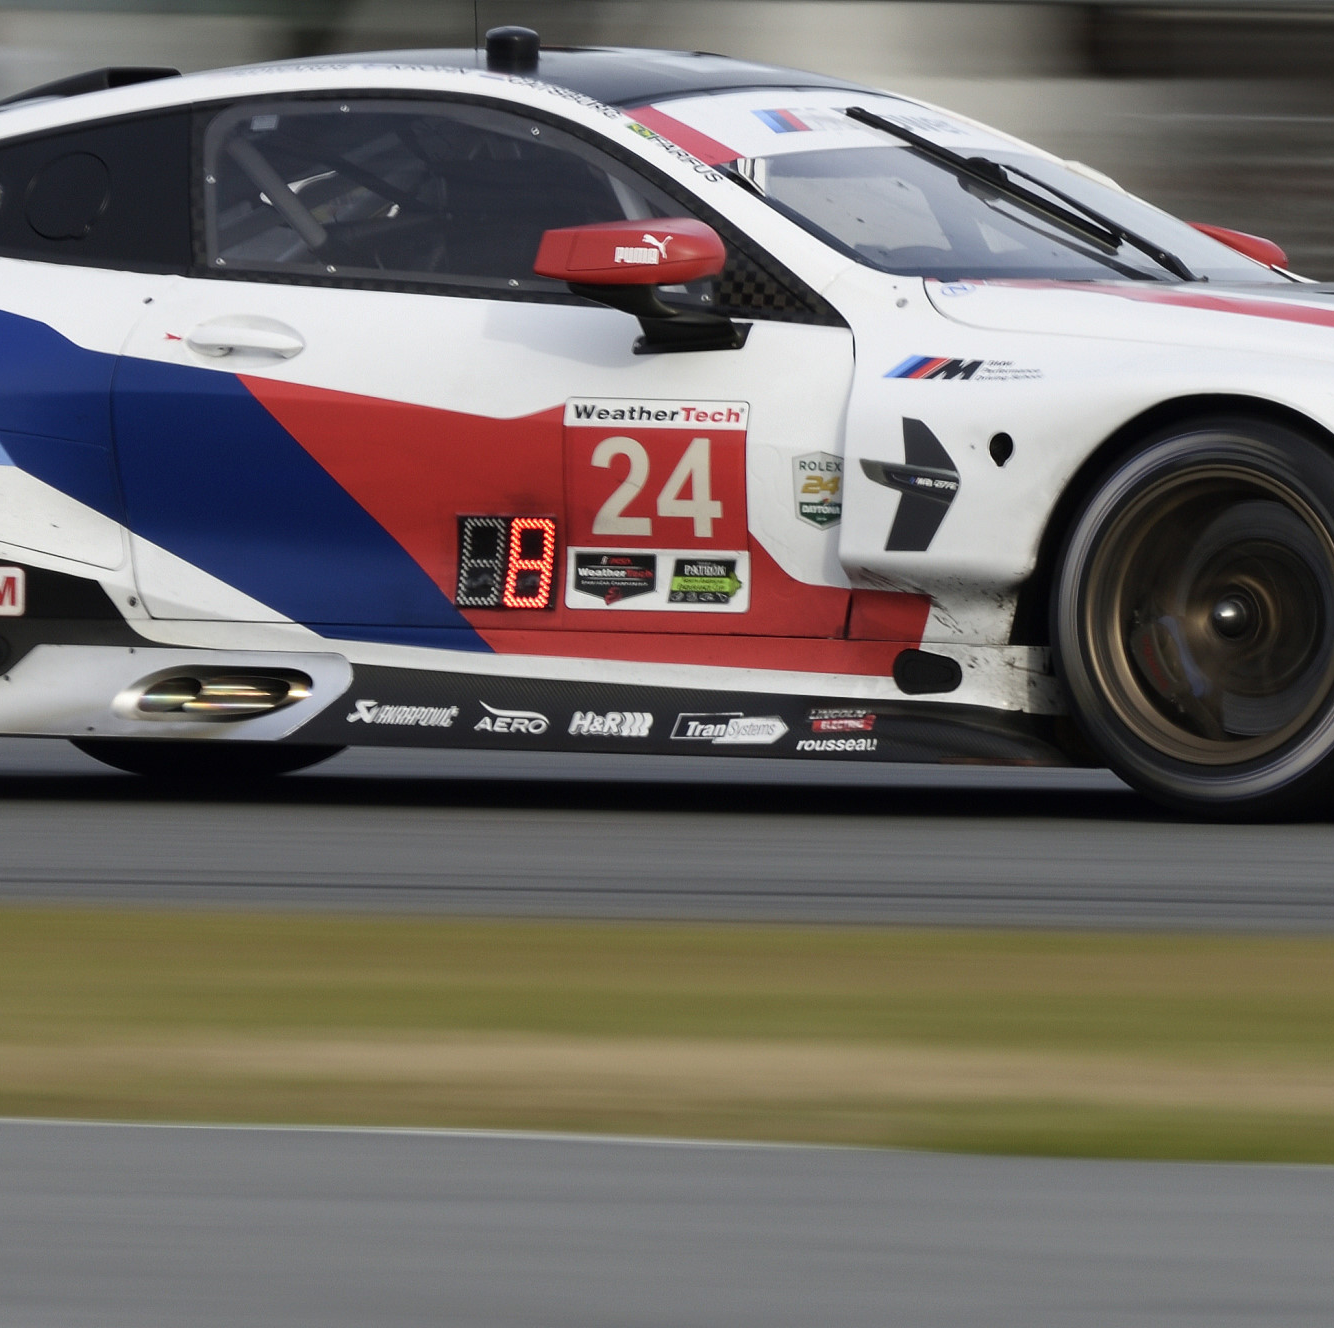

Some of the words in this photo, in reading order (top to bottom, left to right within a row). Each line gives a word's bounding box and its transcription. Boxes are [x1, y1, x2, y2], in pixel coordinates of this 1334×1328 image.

[614, 246, 660, 265] PUMA
[574, 404, 741, 422] WeatherTech
[799, 461, 842, 472] ROLEX
[591, 436, 723, 538] 24
[801, 475, 841, 495] 24
[802, 505, 841, 514] DAYTONA
[474, 717, 547, 735] AERO
[820, 719, 865, 730] ELECTRIC
[796, 738, 878, 751] rousseau
